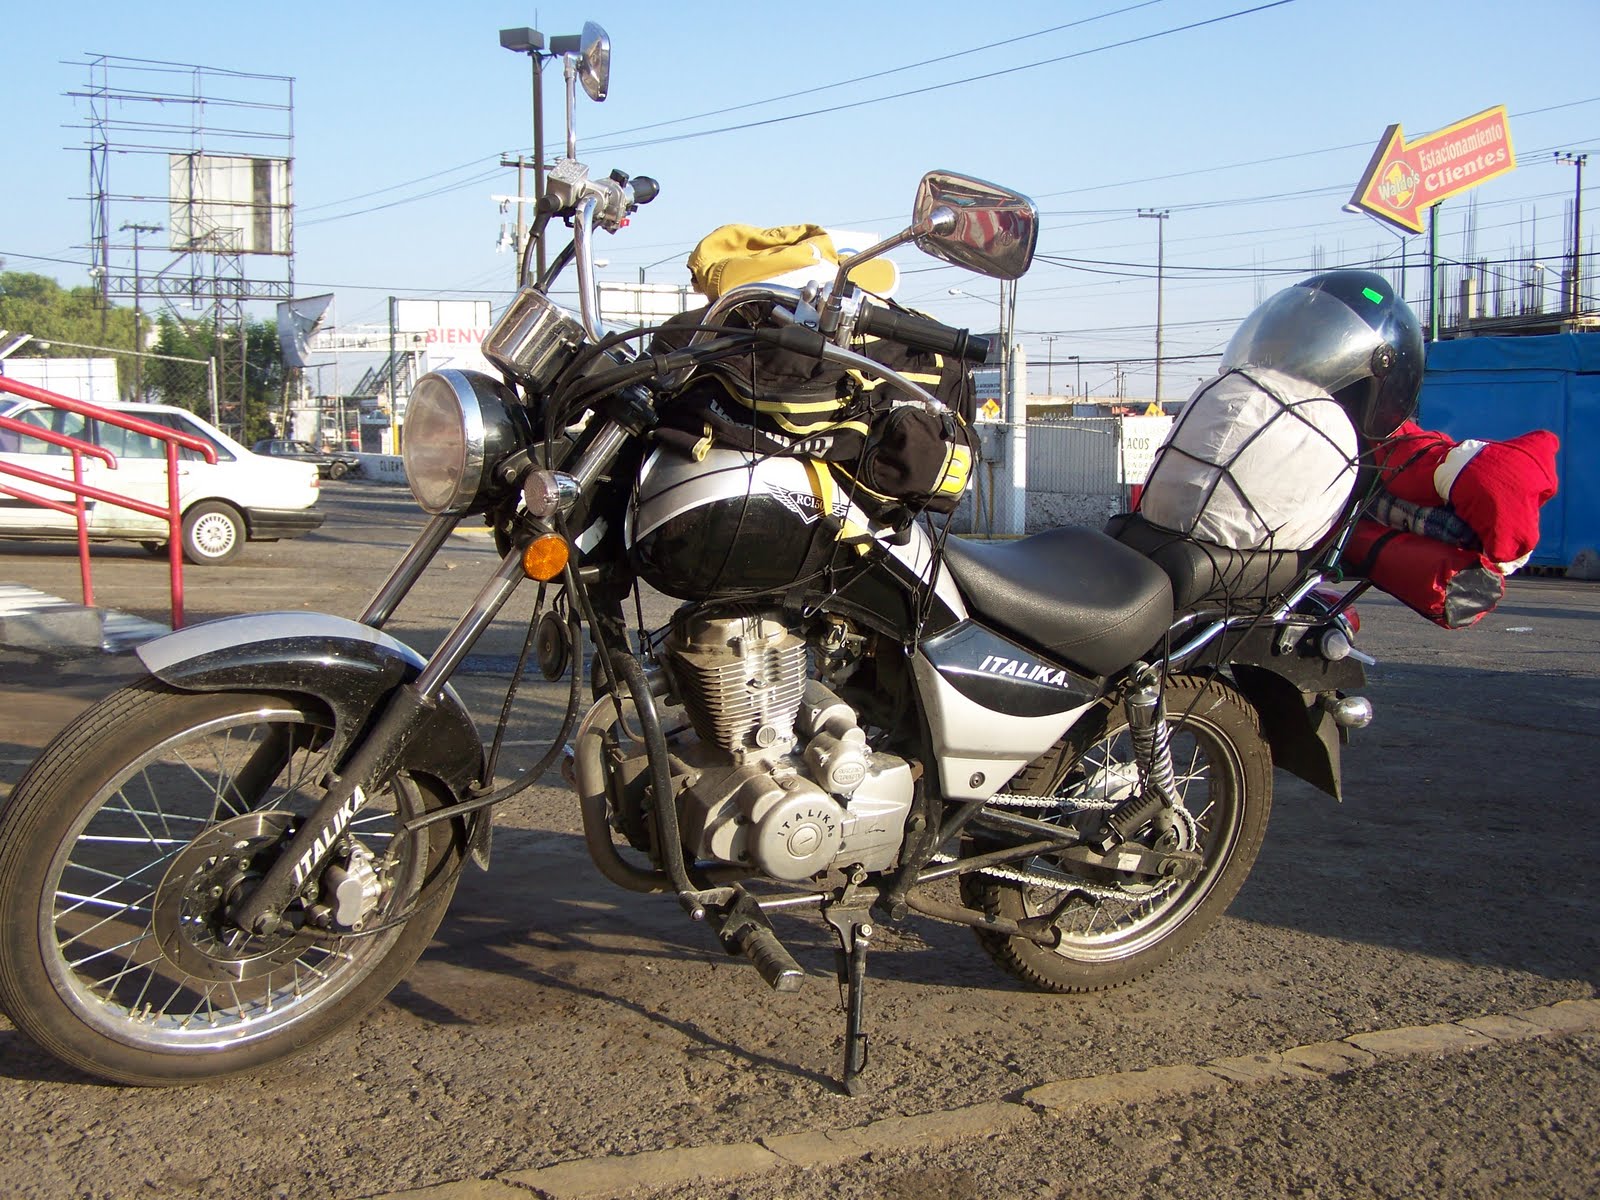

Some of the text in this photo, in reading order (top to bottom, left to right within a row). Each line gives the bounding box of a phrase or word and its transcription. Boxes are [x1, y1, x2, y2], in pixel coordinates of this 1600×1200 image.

[1418, 123, 1502, 172] Estacionamiento
[1378, 169, 1420, 201] Waldo's
[1424, 148, 1506, 192] Clientes
[1124, 437, 1150, 450] ACOS
[978, 655, 1066, 687] ITALIKA
[294, 785, 366, 886] ITALIKA
[777, 809, 835, 836] ITALIKA
